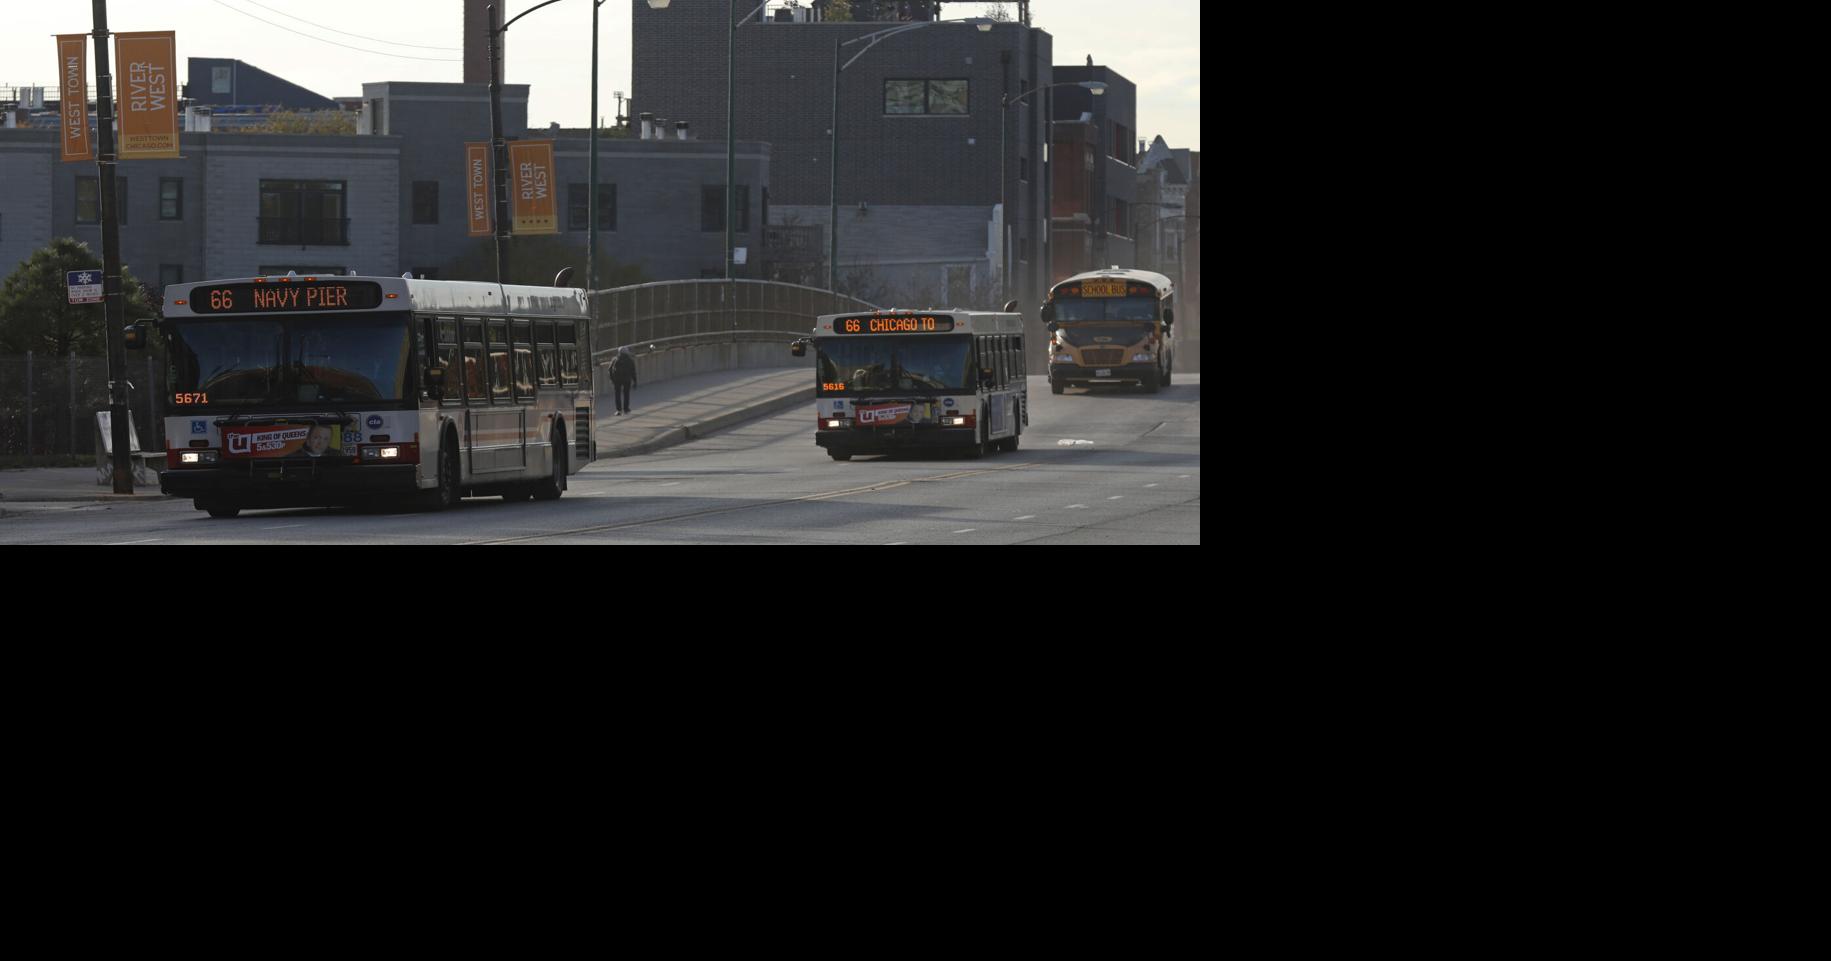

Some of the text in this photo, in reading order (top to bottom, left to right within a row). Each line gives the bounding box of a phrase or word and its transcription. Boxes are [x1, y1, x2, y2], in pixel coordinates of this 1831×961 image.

[67, 56, 81, 139] WEST TOWN
[129, 61, 148, 111] RIVER
[148, 63, 166, 111] WEST
[473, 159, 485, 221] WEST TOWN
[520, 162, 533, 200] RIVER
[534, 163, 548, 200] WEST
[210, 286, 348, 310] 66 NAVY PIER
[1082, 284, 1126, 296] SCHOOL BUS
[845, 317, 935, 332] 66 CHICAGO TO
[175, 392, 209, 404] 5671
[822, 383, 846, 391] 5616
[256, 433, 272, 441] KING
[282, 431, 306, 440] QUEENS
